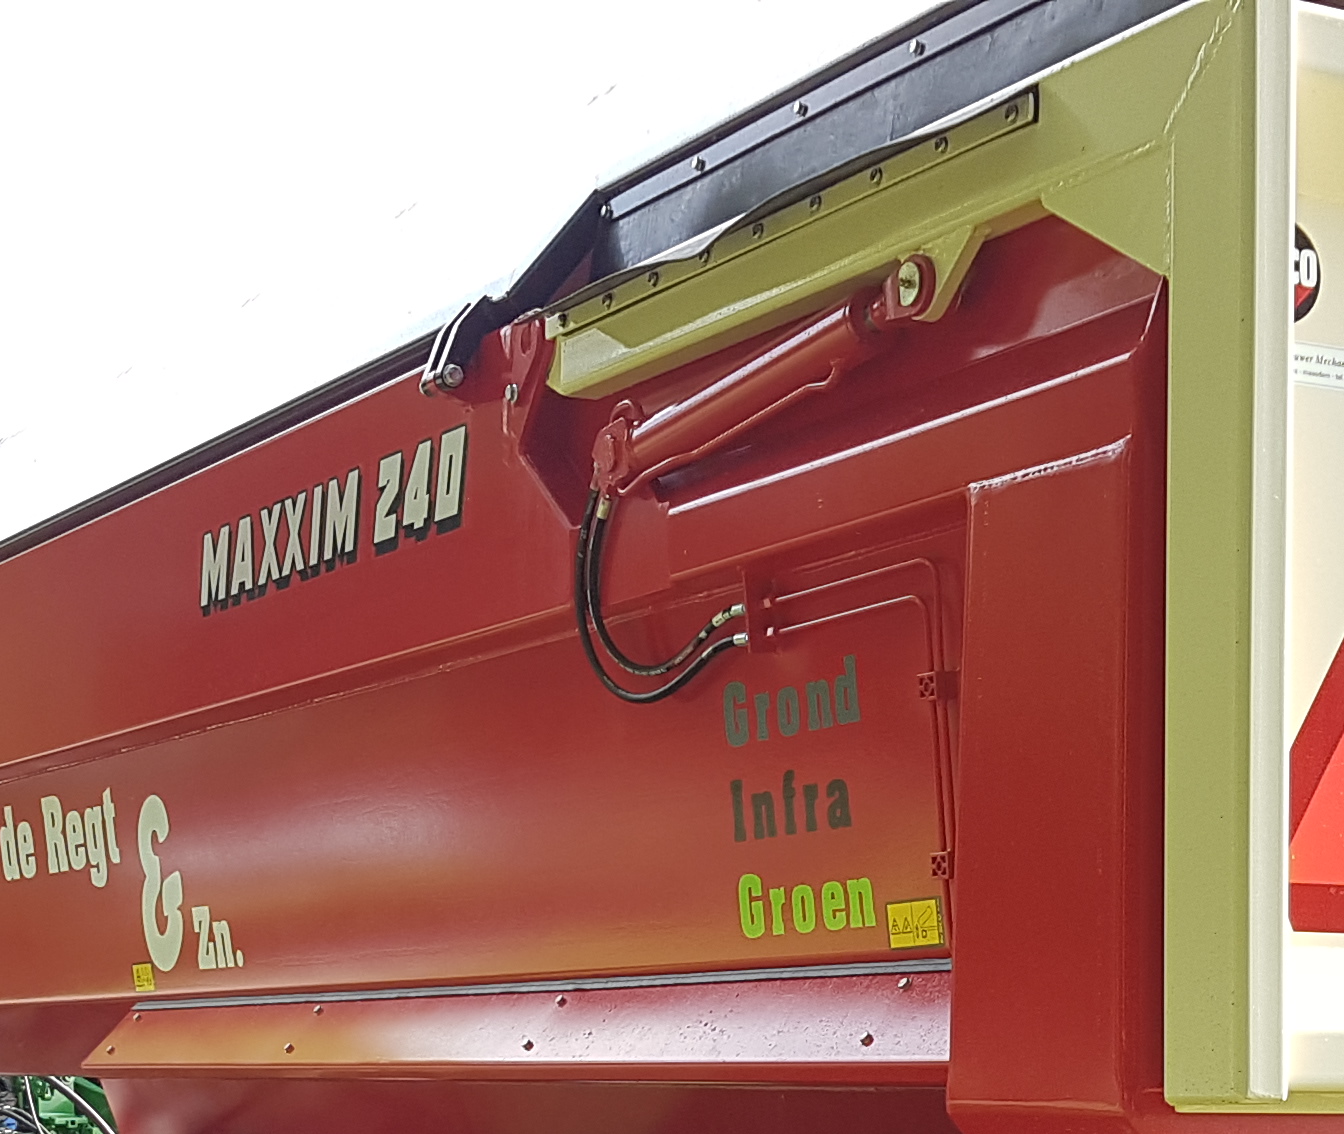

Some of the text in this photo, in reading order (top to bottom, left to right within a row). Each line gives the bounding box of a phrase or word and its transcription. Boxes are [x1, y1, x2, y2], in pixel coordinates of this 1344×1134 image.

[200, 425, 468, 617] MAXXIM 240
[723, 654, 862, 747] Grond
[729, 769, 853, 842] Infra
[0, 805, 38, 882] de
[40, 786, 122, 889] Regt
[137, 794, 184, 973] &
[191, 905, 245, 970] Zn.
[737, 873, 877, 939] Groen
